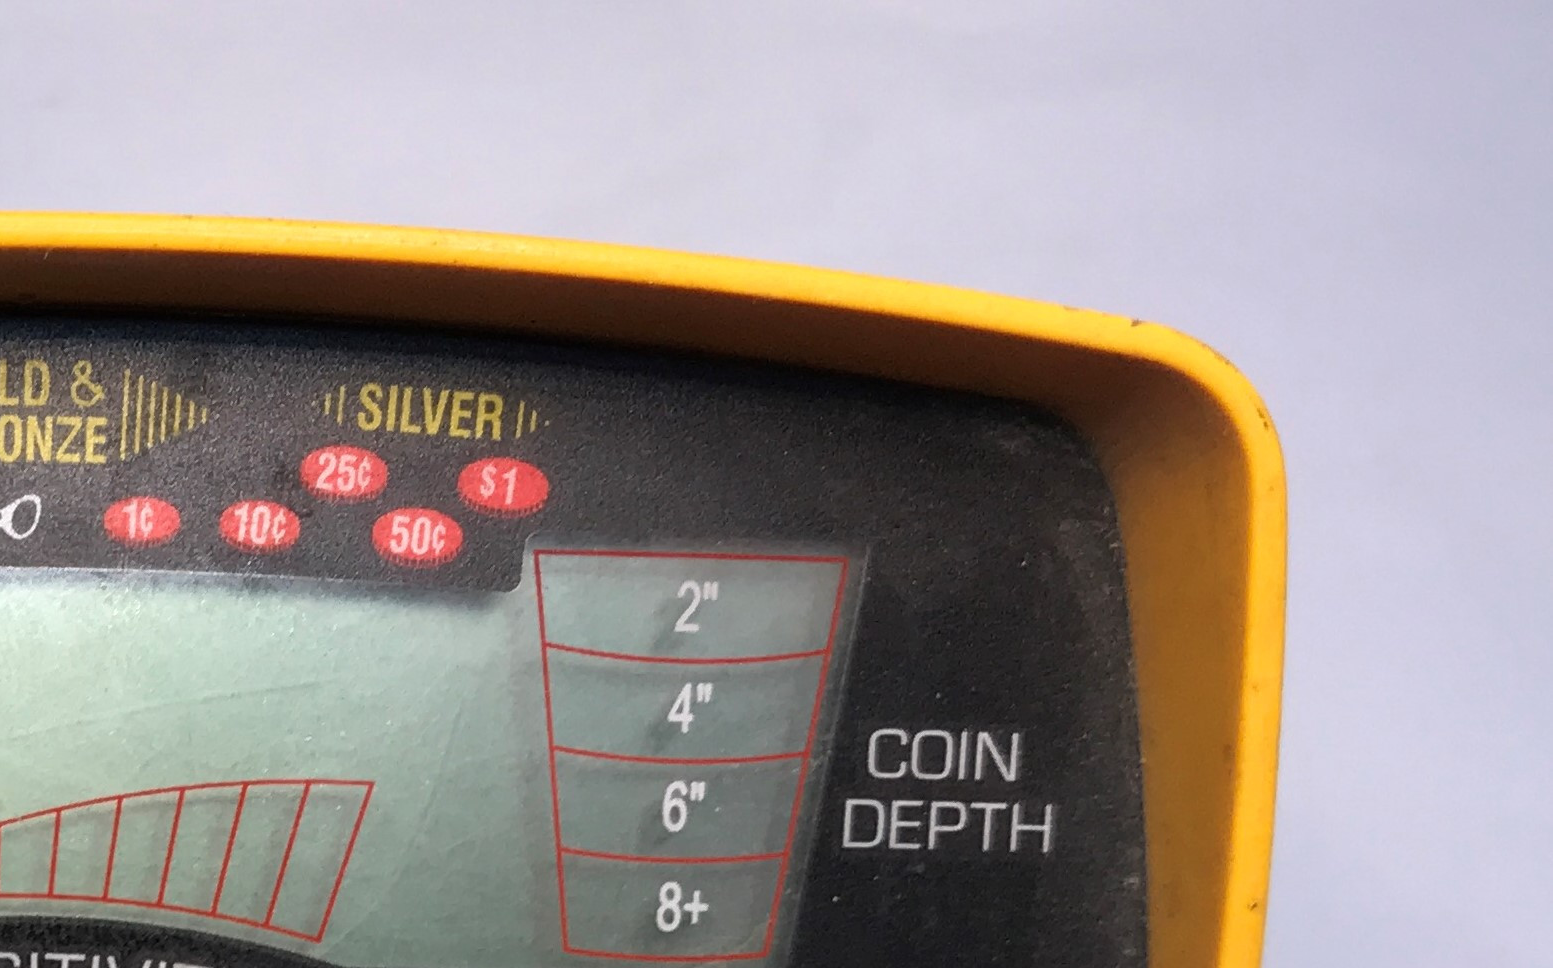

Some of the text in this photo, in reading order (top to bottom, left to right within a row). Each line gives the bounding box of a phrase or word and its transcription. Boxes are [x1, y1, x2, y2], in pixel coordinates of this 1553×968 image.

[357, 383, 503, 439] SILVER
[866, 728, 1021, 782] COIN
[841, 800, 1054, 853] DEPTH
